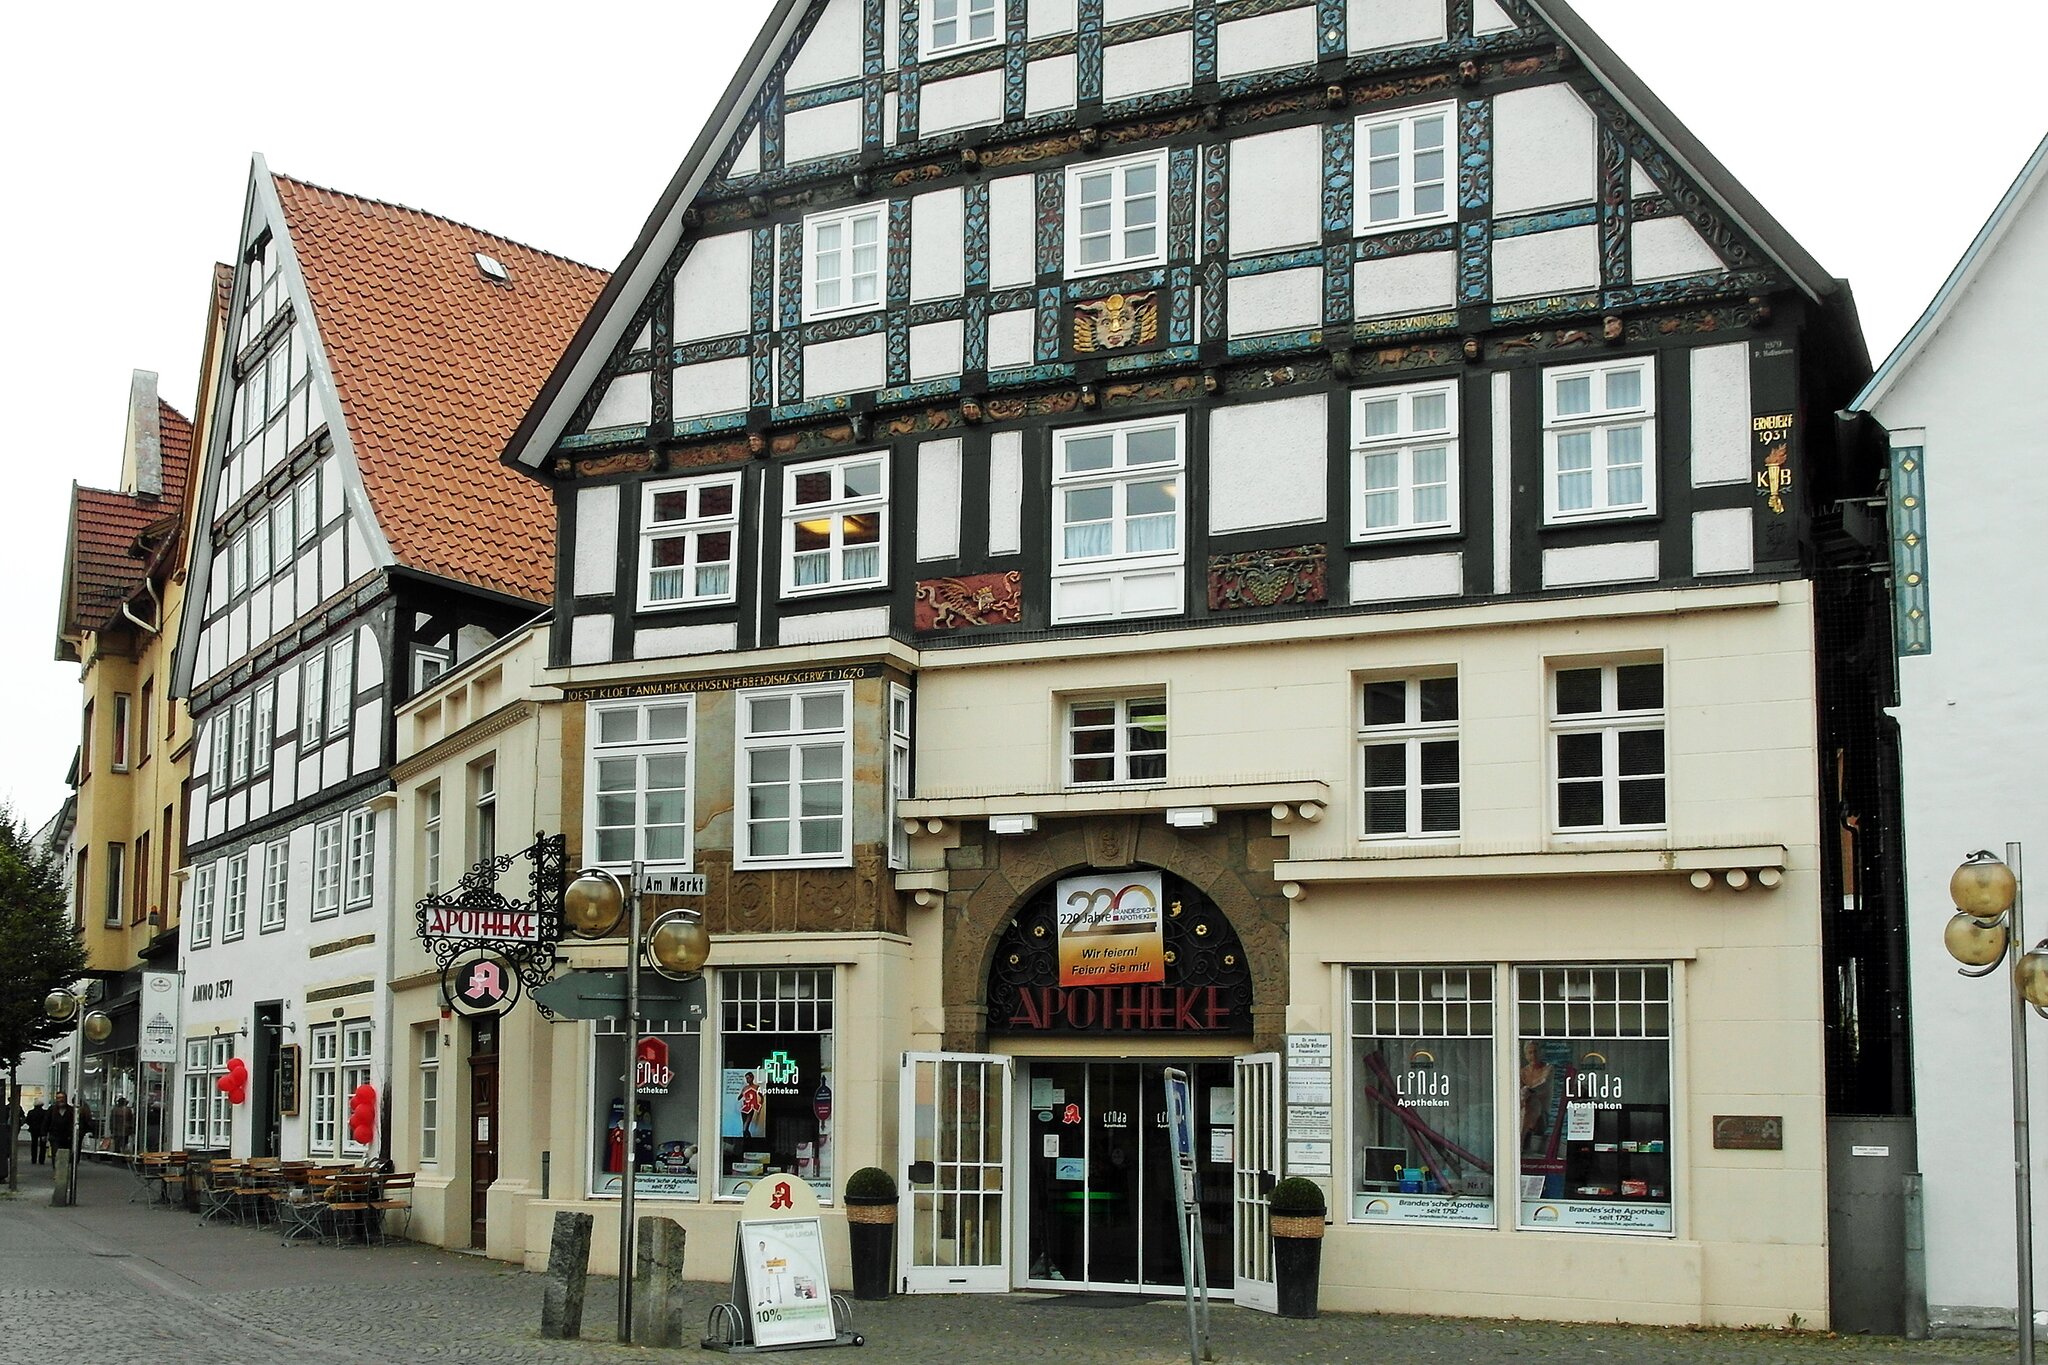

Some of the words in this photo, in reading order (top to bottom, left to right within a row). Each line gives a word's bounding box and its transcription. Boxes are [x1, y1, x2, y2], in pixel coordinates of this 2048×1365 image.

[1759, 429, 1788, 446] 1931
[1757, 471, 1769, 488] K
[1781, 469, 1792, 485] B
[838, 667, 864, 680] 1620
[645, 878, 663, 891] Am
[670, 877, 705, 893] Markt
[429, 908, 537, 938] APOTHEKE
[1082, 911, 1112, 924] Jahre
[1082, 948, 1101, 959] Wir
[1104, 946, 1139, 958] feiern!
[1072, 965, 1106, 976] Feiern
[1109, 963, 1126, 973] Sie
[1129, 961, 1150, 973] mit!
[192, 983, 214, 1002] ANNO
[215, 979, 233, 999] 1571
[1008, 986, 1231, 1030] APOTHEKE
[637, 1062, 669, 1084] inda
[756, 1087, 799, 1096] Apotheken
[1397, 1098, 1450, 1108] Apotheken
[1566, 1101, 1622, 1111] Apotheken
[1399, 1200, 1449, 1208] Brandes'sche
[1451, 1201, 1490, 1209] Apotheke
[1569, 1206, 1622, 1214] Brandes'sche
[1624, 1208, 1666, 1216] Apotheke
[756, 1308, 783, 1323] 10%
